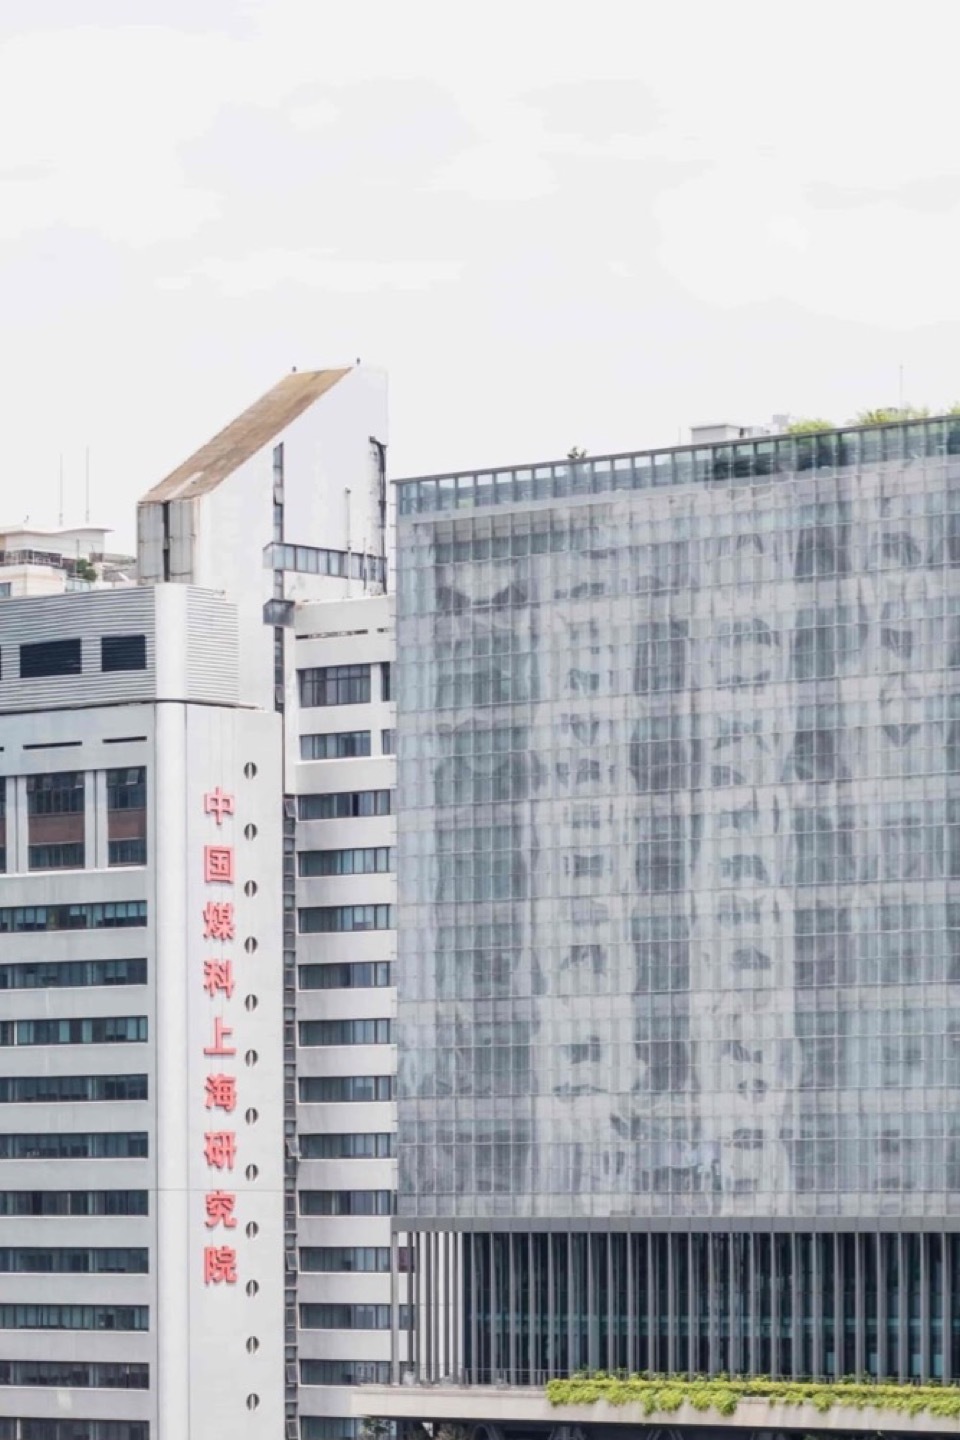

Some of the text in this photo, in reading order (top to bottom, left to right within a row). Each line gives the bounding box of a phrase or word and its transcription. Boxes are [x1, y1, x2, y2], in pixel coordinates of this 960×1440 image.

[202, 786, 238, 1286] 中国煤科上海研究院
